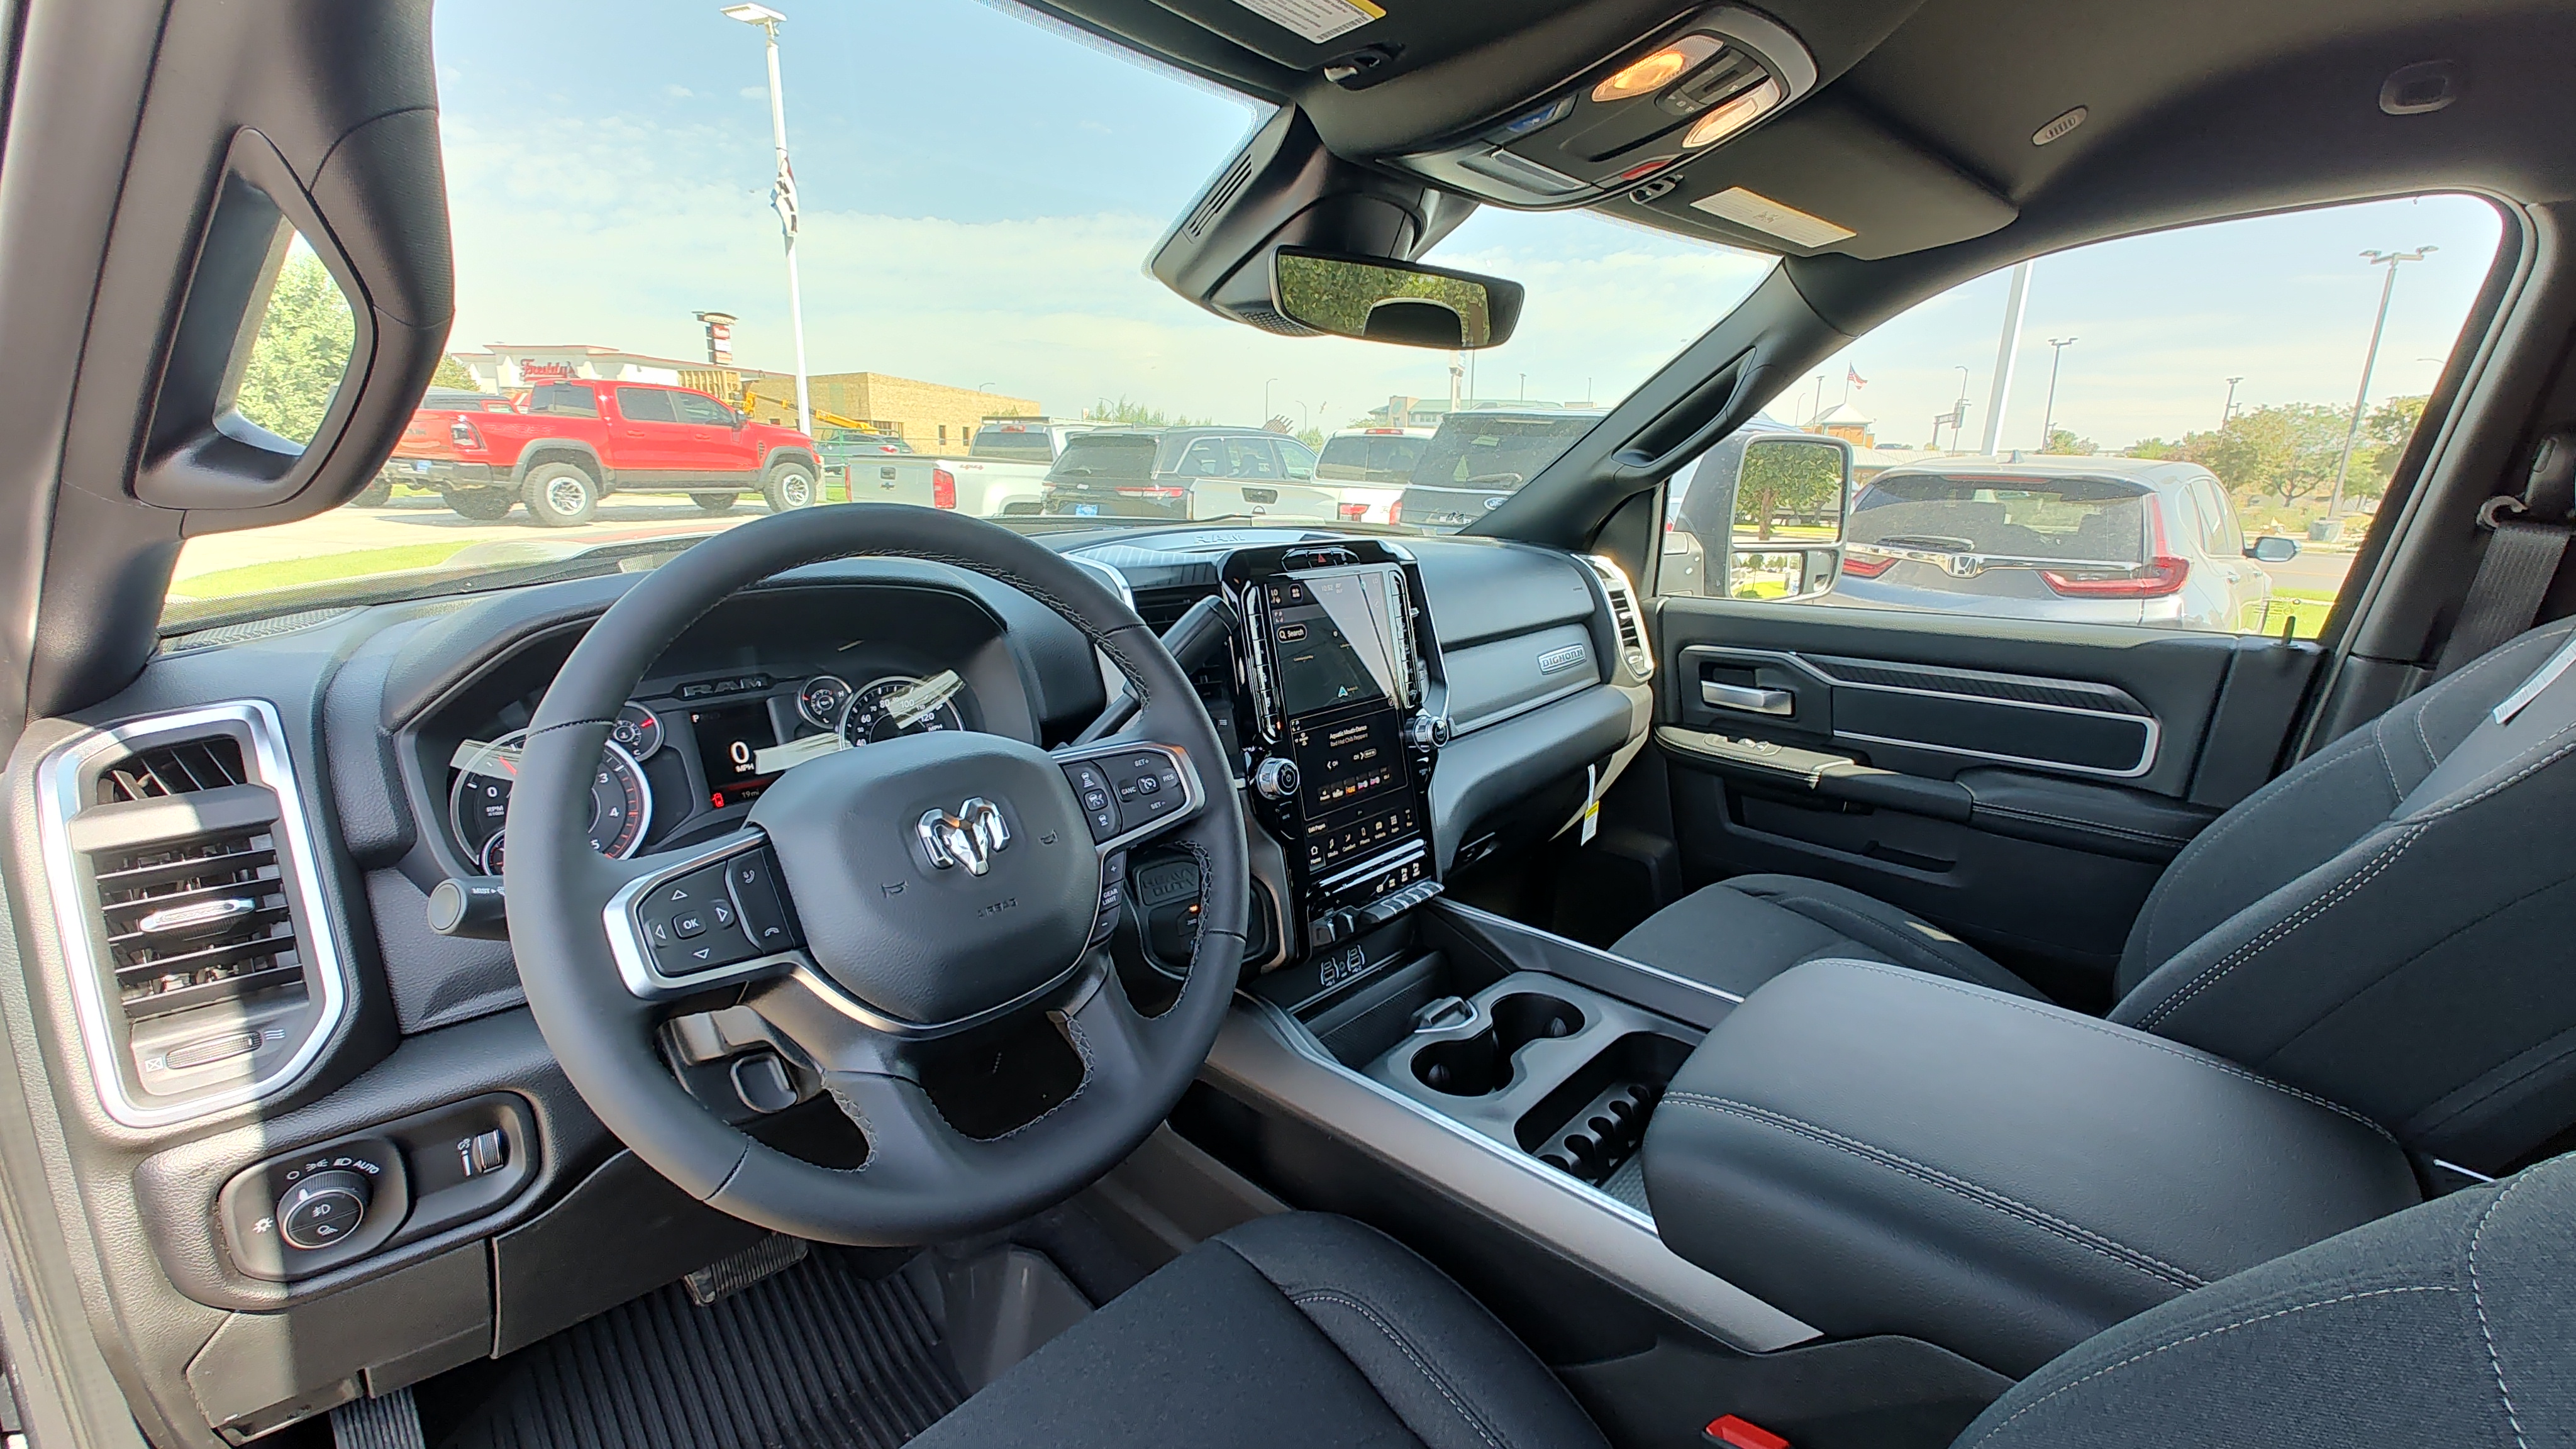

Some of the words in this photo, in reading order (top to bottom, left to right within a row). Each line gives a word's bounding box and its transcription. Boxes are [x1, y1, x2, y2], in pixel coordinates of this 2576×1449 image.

[519, 358, 576, 380] Freddy's
[1287, 628, 1304, 638] Search
[684, 677, 768, 697] RAM
[879, 699, 891, 709] 80
[900, 699, 916, 709] 100
[692, 714, 700, 723] P
[860, 714, 872, 724] 60
[921, 712, 935, 722] 120
[928, 723, 943, 732] MPH
[856, 738, 867, 747] 40
[730, 741, 750, 764] 0
[735, 763, 755, 773] MPH
[598, 772, 609, 784] 3
[486, 786, 498, 798] 0
[1121, 786, 1137, 796] CANC
[609, 807, 620, 818] 4
[590, 839, 601, 850] 5
[1342, 843, 1357, 853] Comfort
[1143, 867, 1195, 889] HEAVY
[1153, 878, 1195, 897] DUTY
[1103, 889, 1119, 899] GEAR
[682, 917, 700, 930] OK
[353, 1160, 380, 1175] AUTO
